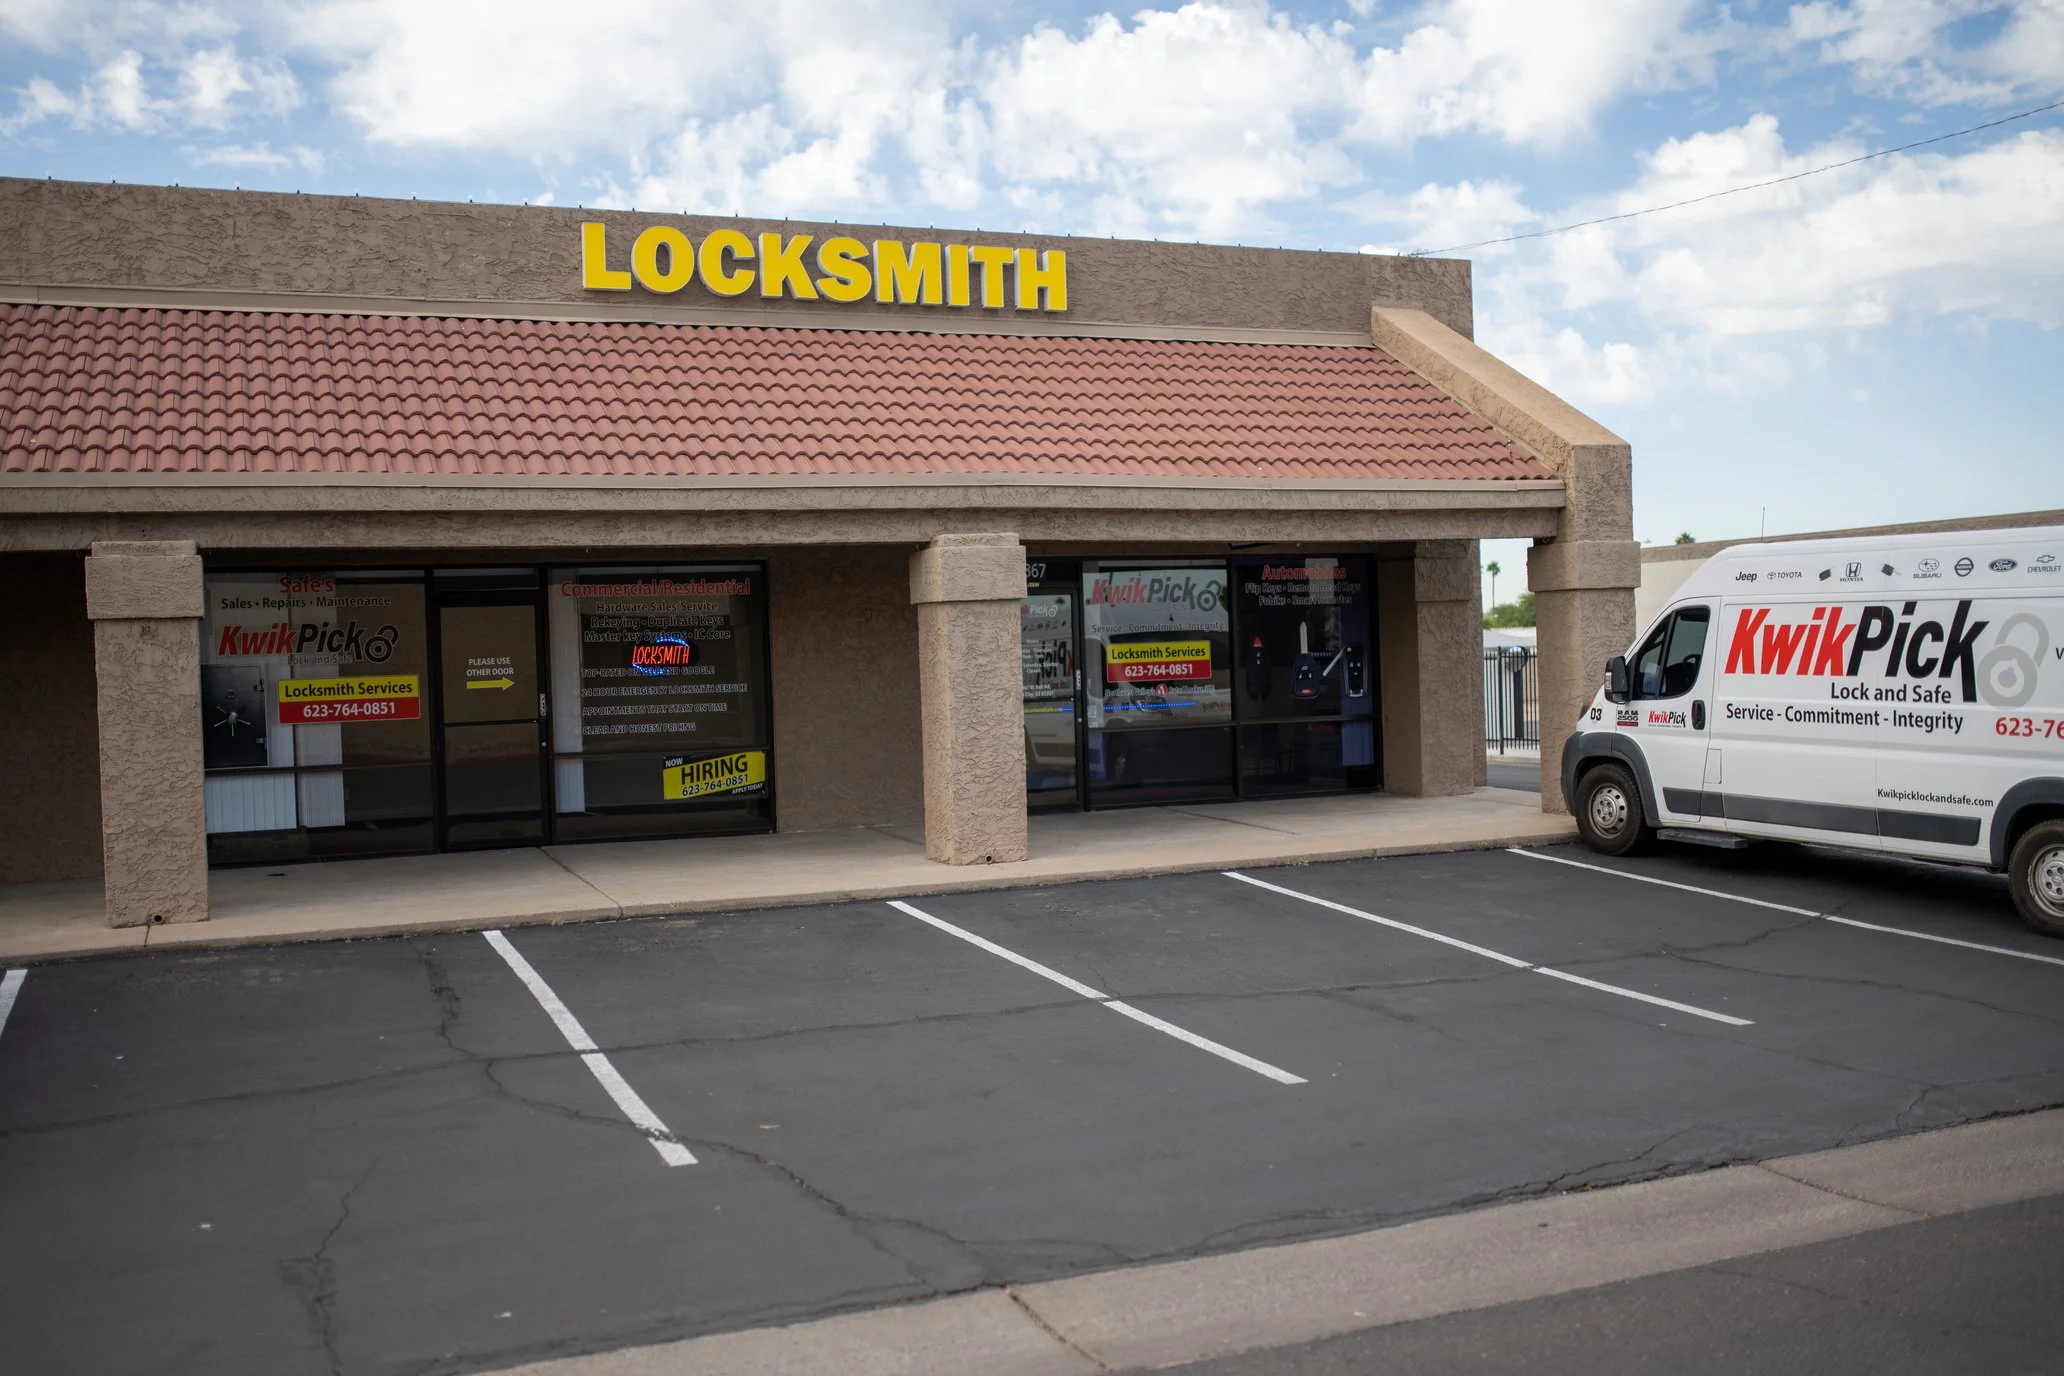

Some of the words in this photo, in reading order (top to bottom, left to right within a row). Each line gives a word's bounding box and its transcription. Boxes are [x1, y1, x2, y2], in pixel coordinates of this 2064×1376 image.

[581, 222, 1067, 311] LOCKSMITH
[1261, 564, 1347, 580] Automobiles
[1735, 571, 1757, 582] Jeep
[2027, 565, 2062, 573] CHEVROLET
[280, 575, 334, 593] Safe's
[1091, 576, 1198, 610] KwikPick
[221, 598, 253, 610] Sales
[262, 598, 306, 611] Repairs
[316, 596, 391, 607] Maintenance
[596, 601, 647, 613] Hardware
[590, 615, 640, 629] Rekeying
[648, 614, 698, 628] Duplicate
[700, 615, 725, 627] Keys
[1092, 624, 1122, 633] Service
[1128, 623, 1182, 632] Commitment
[1188, 621, 1224, 632] Integrity
[218, 621, 366, 660] KwikPick
[585, 630, 622, 643] Master
[622, 630, 643, 643] key
[704, 629, 731, 640] Core
[632, 646, 691, 664] LOCKSMITH
[1112, 648, 1163, 660] Locksmith
[1165, 646, 1206, 658] Services
[1724, 600, 1990, 702] KwikPick
[468, 658, 495, 667] PLEASE
[497, 657, 511, 665] USE
[466, 668, 492, 677] OTHER
[492, 667, 514, 676] DOOR
[681, 665, 715, 675] GOOGLE
[1125, 664, 1193, 677] 623-764-0851
[285, 683, 354, 698] Locksmith
[358, 681, 413, 695] Services
[593, 687, 619, 697] HOUR
[619, 685, 668, 696] EMERGENCY
[668, 684, 715, 695] LOCKSMITH
[715, 683, 747, 693] SERVICE
[1831, 682, 1869, 700] Lock
[1874, 684, 1907, 702] and
[1912, 685, 1951, 704] Safe
[303, 702, 395, 718] 623-764-0851
[583, 706, 646, 716] APPOINTMENTS
[647, 705, 669, 714] THAT
[669, 704, 694, 713] START
[694, 703, 706, 712] ON
[706, 702, 728, 712] TIME
[1590, 708, 1602, 720] 03
[1648, 710, 1686, 728] KwikPick
[1726, 703, 1774, 721] Service
[1785, 706, 1880, 726] Commitment
[1893, 710, 1963, 734] Integrity
[583, 725, 611, 735] CLEAR
[611, 724, 629, 734] AND
[629, 723, 663, 733] HONEST
[663, 722, 696, 732] PRICING
[1995, 716, 2064, 739] 623-76
[665, 757, 683, 767] NOW
[681, 755, 748, 785] HIRING
[682, 774, 749, 796] 623-764-0851
[748, 783, 763, 791] TODAY
[1877, 788, 1994, 807] Kwikpicklockandsafe.com
